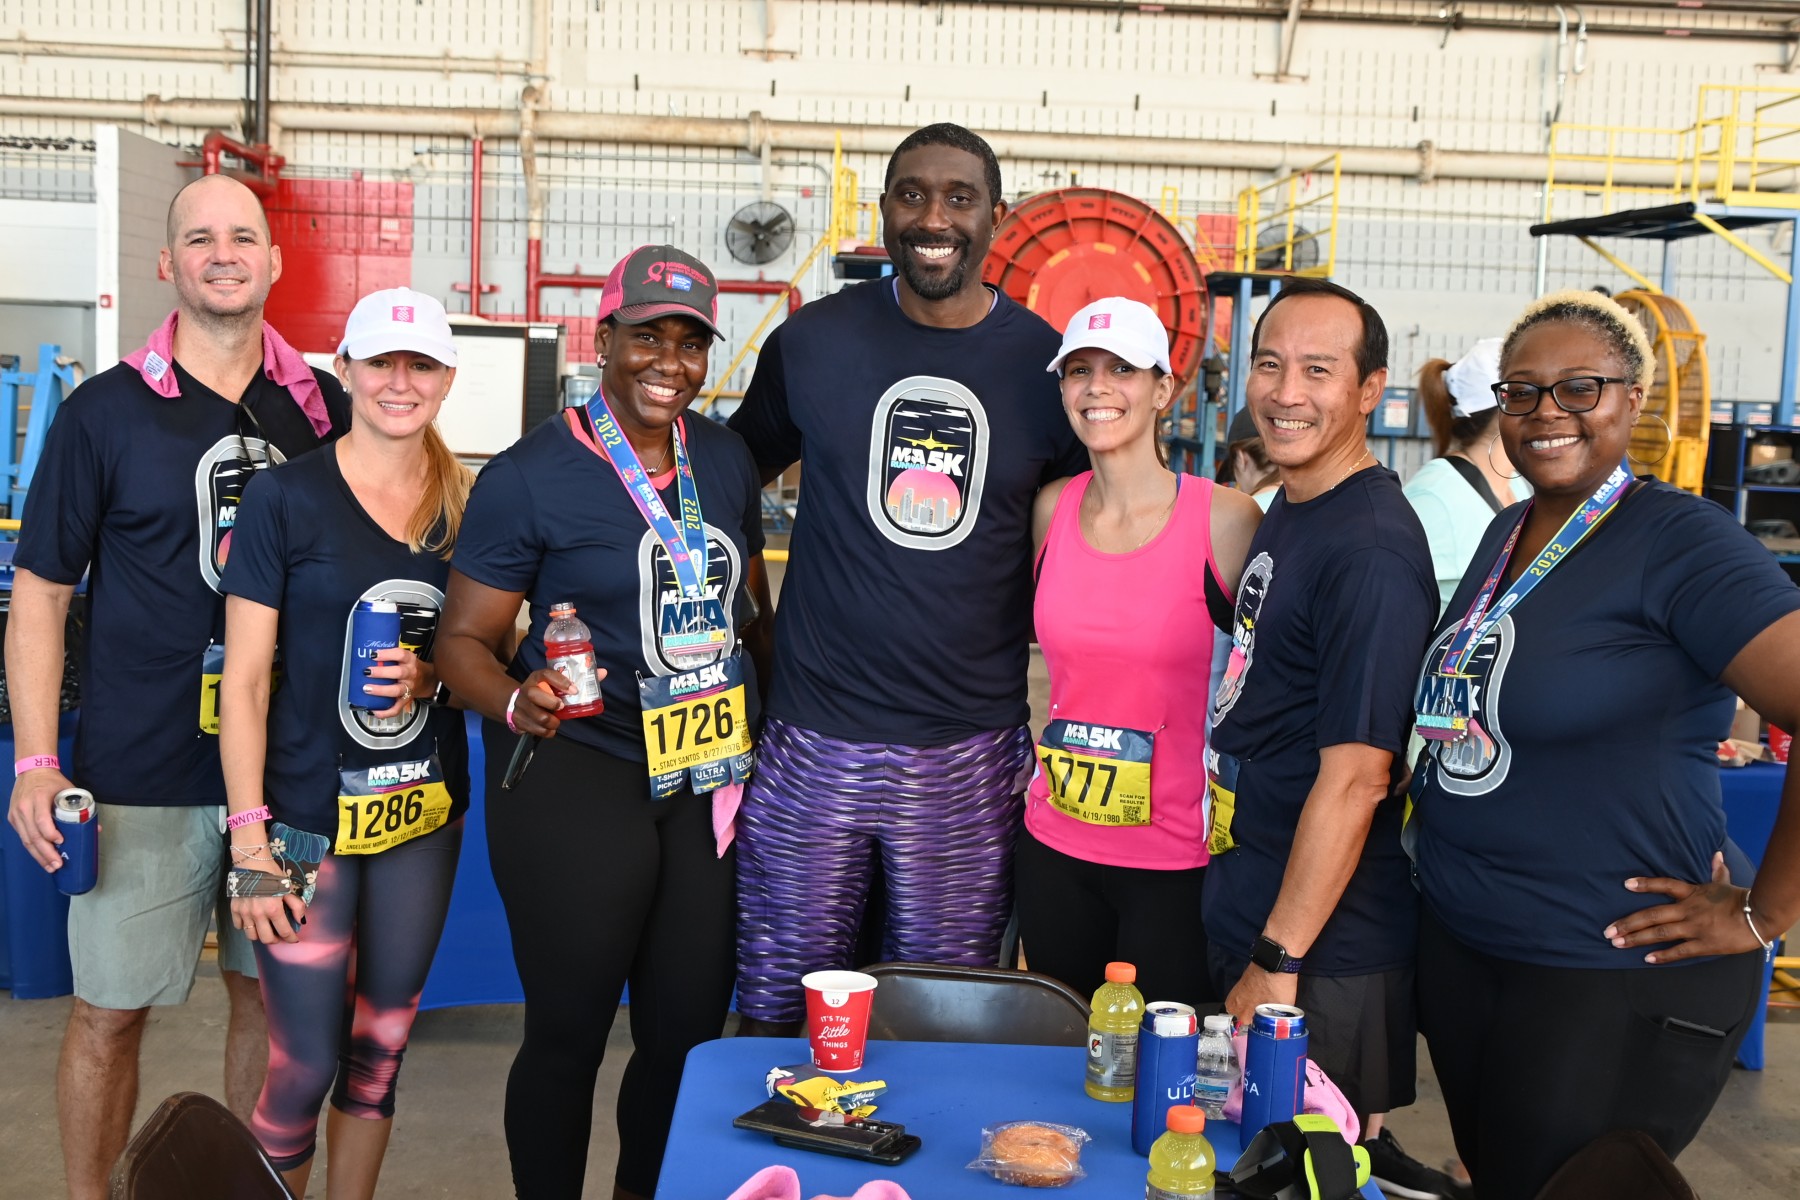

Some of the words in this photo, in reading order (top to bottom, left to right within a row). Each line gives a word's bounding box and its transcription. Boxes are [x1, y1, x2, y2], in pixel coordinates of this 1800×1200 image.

[594, 413, 622, 449] 2022
[890, 460, 926, 471] RUNWAY
[683, 498, 701, 530] 2022
[1530, 543, 1567, 577] 2022
[699, 662, 729, 689] 5K
[670, 684, 700, 696] RUNWAY
[650, 697, 734, 755] 1726
[1062, 736, 1089, 746] RUNWAY
[1087, 727, 1123, 751] 5K
[659, 759, 677, 770] STACY
[678, 752, 701, 765] SANTOS
[703, 743, 741, 759] 8/27/1976
[399, 759, 431, 783] 5K
[657, 770, 683, 783] T-SHIRT
[695, 765, 726, 780] ULTRA
[367, 778, 399, 787] RUNWAY
[656, 778, 683, 791] PICK-UP
[1041, 753, 1118, 807] 1777
[344, 789, 425, 840] 1286
[1082, 810, 1120, 824] 4/19/1980
[345, 842, 372, 850] ANGELIQUE
[820, 1015, 834, 1023] IT'S
[835, 1015, 850, 1023] THE
[818, 1024, 850, 1040] Little
[822, 1040, 848, 1049] THINGS
[814, 1058, 821, 1066] 12
